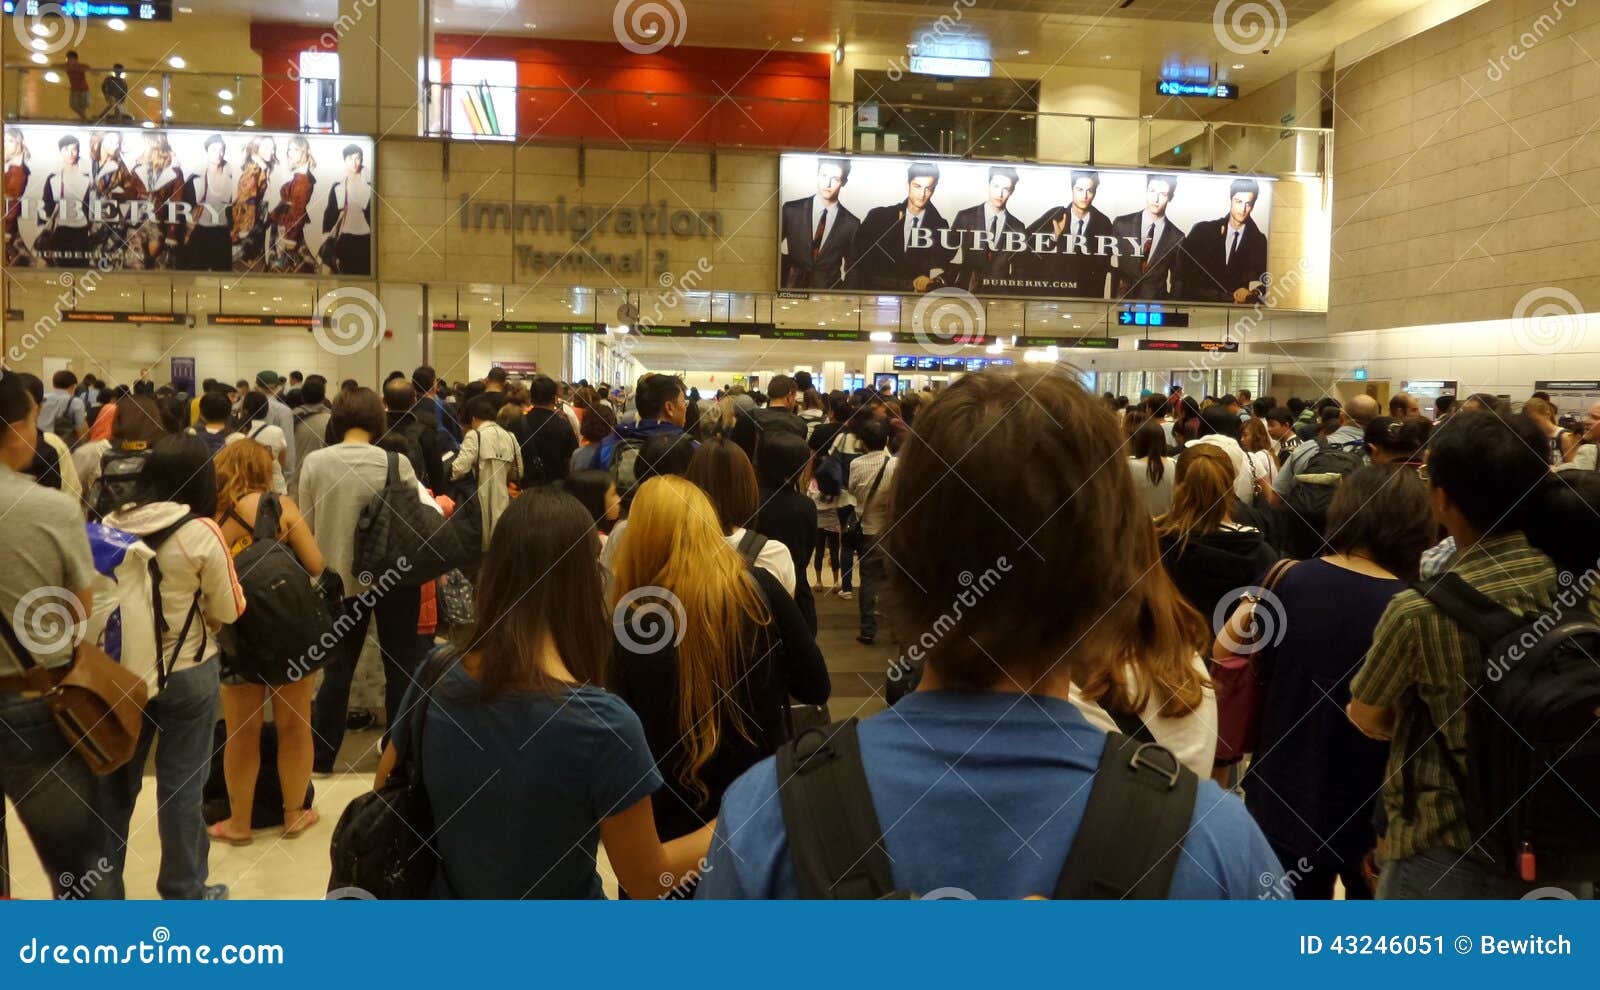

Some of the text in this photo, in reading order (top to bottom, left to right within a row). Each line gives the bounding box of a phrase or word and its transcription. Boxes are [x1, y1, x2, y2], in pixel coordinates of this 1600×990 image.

[4, 198, 233, 226] RBERRY
[459, 192, 724, 244] Immigration
[907, 227, 1153, 258] BURBERRY
[516, 245, 643, 273] Terminal
[982, 278, 1078, 289] BURBERRY.COM
